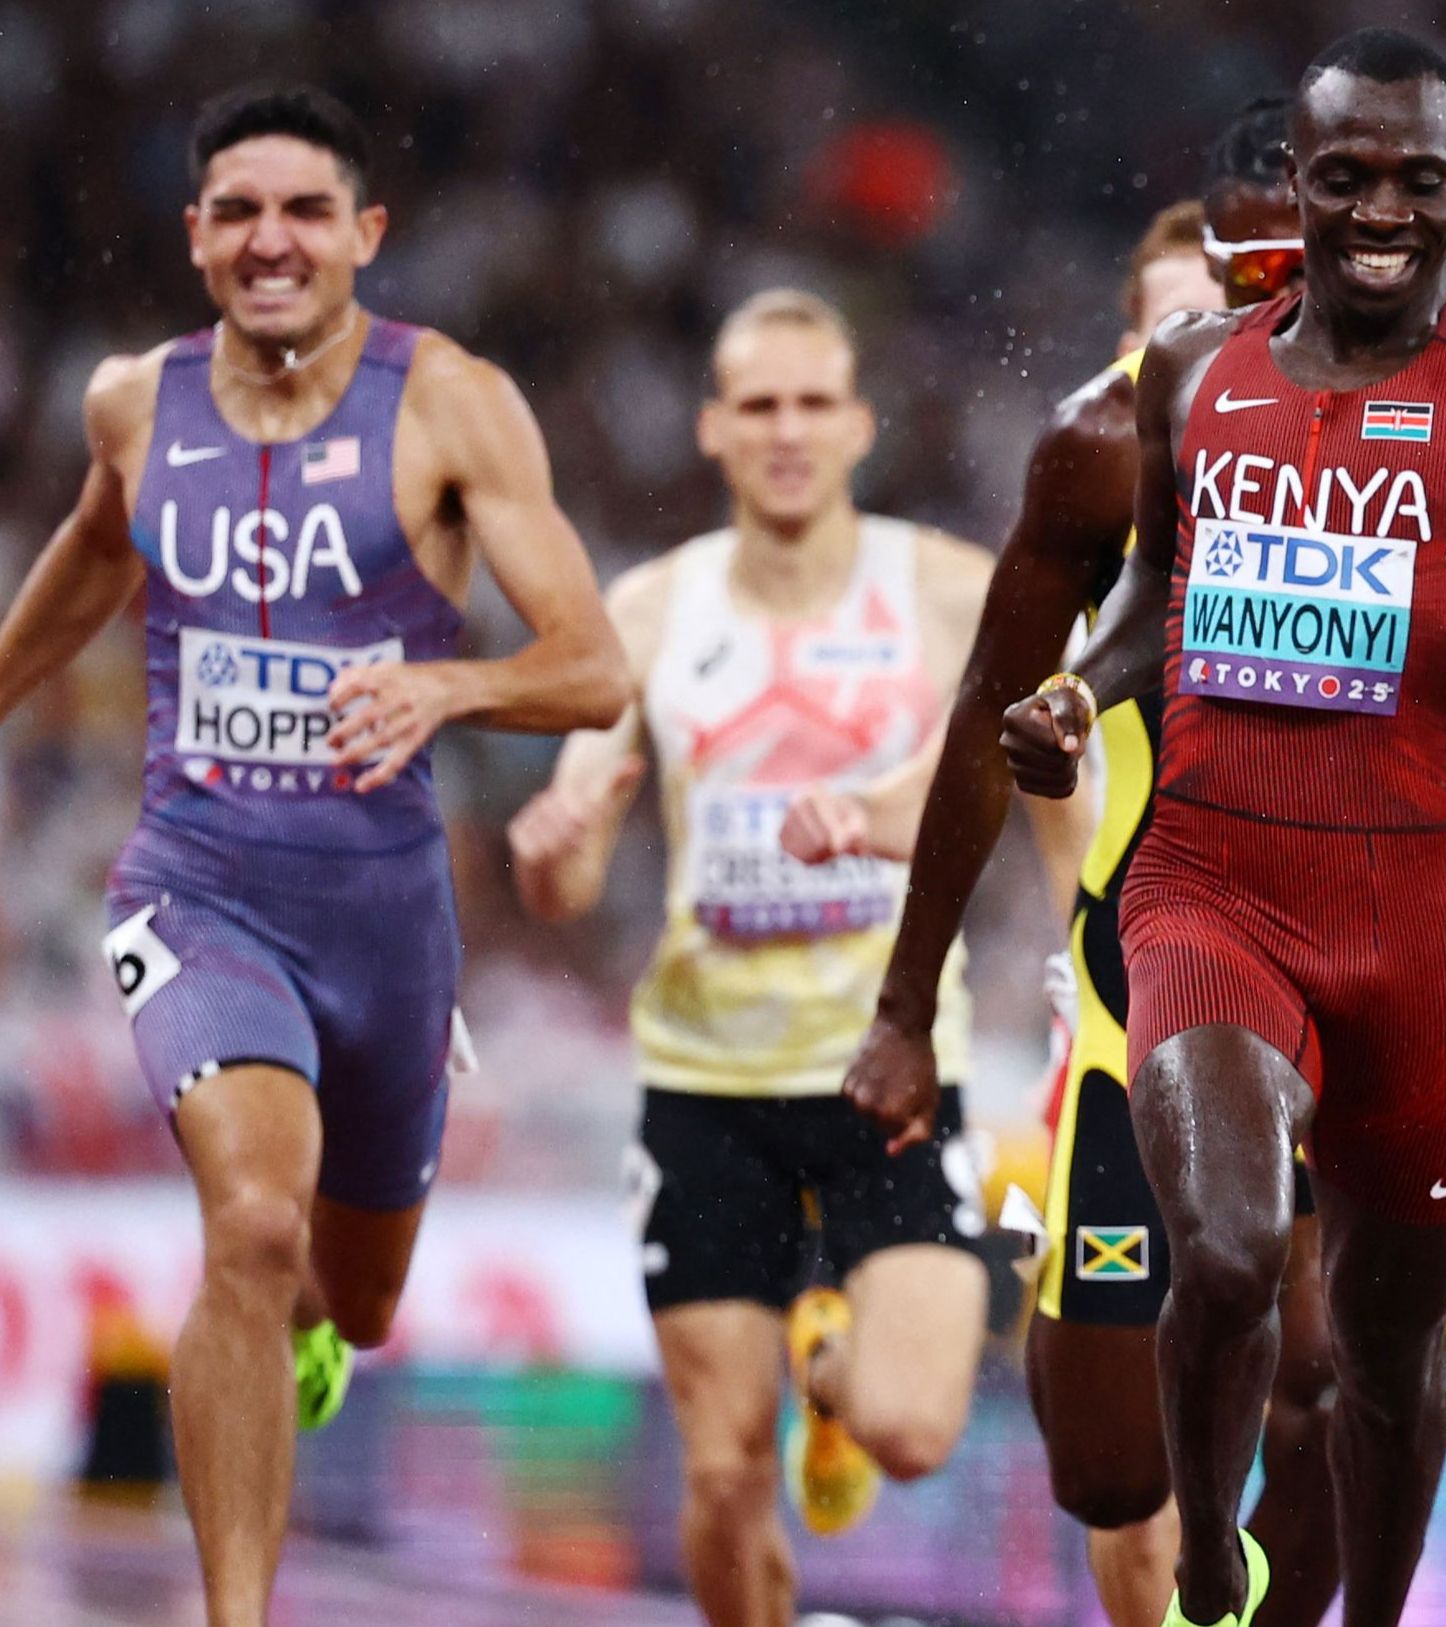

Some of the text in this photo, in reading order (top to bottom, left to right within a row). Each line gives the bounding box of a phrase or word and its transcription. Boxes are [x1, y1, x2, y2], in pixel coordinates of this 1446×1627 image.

[1191, 449, 1432, 542] KENYA
[160, 500, 363, 603] USA
[1246, 532, 1395, 595] TDK
[1192, 591, 1398, 663] WANYONYI
[240, 647, 382, 698] TD
[195, 699, 345, 752] HOPP
